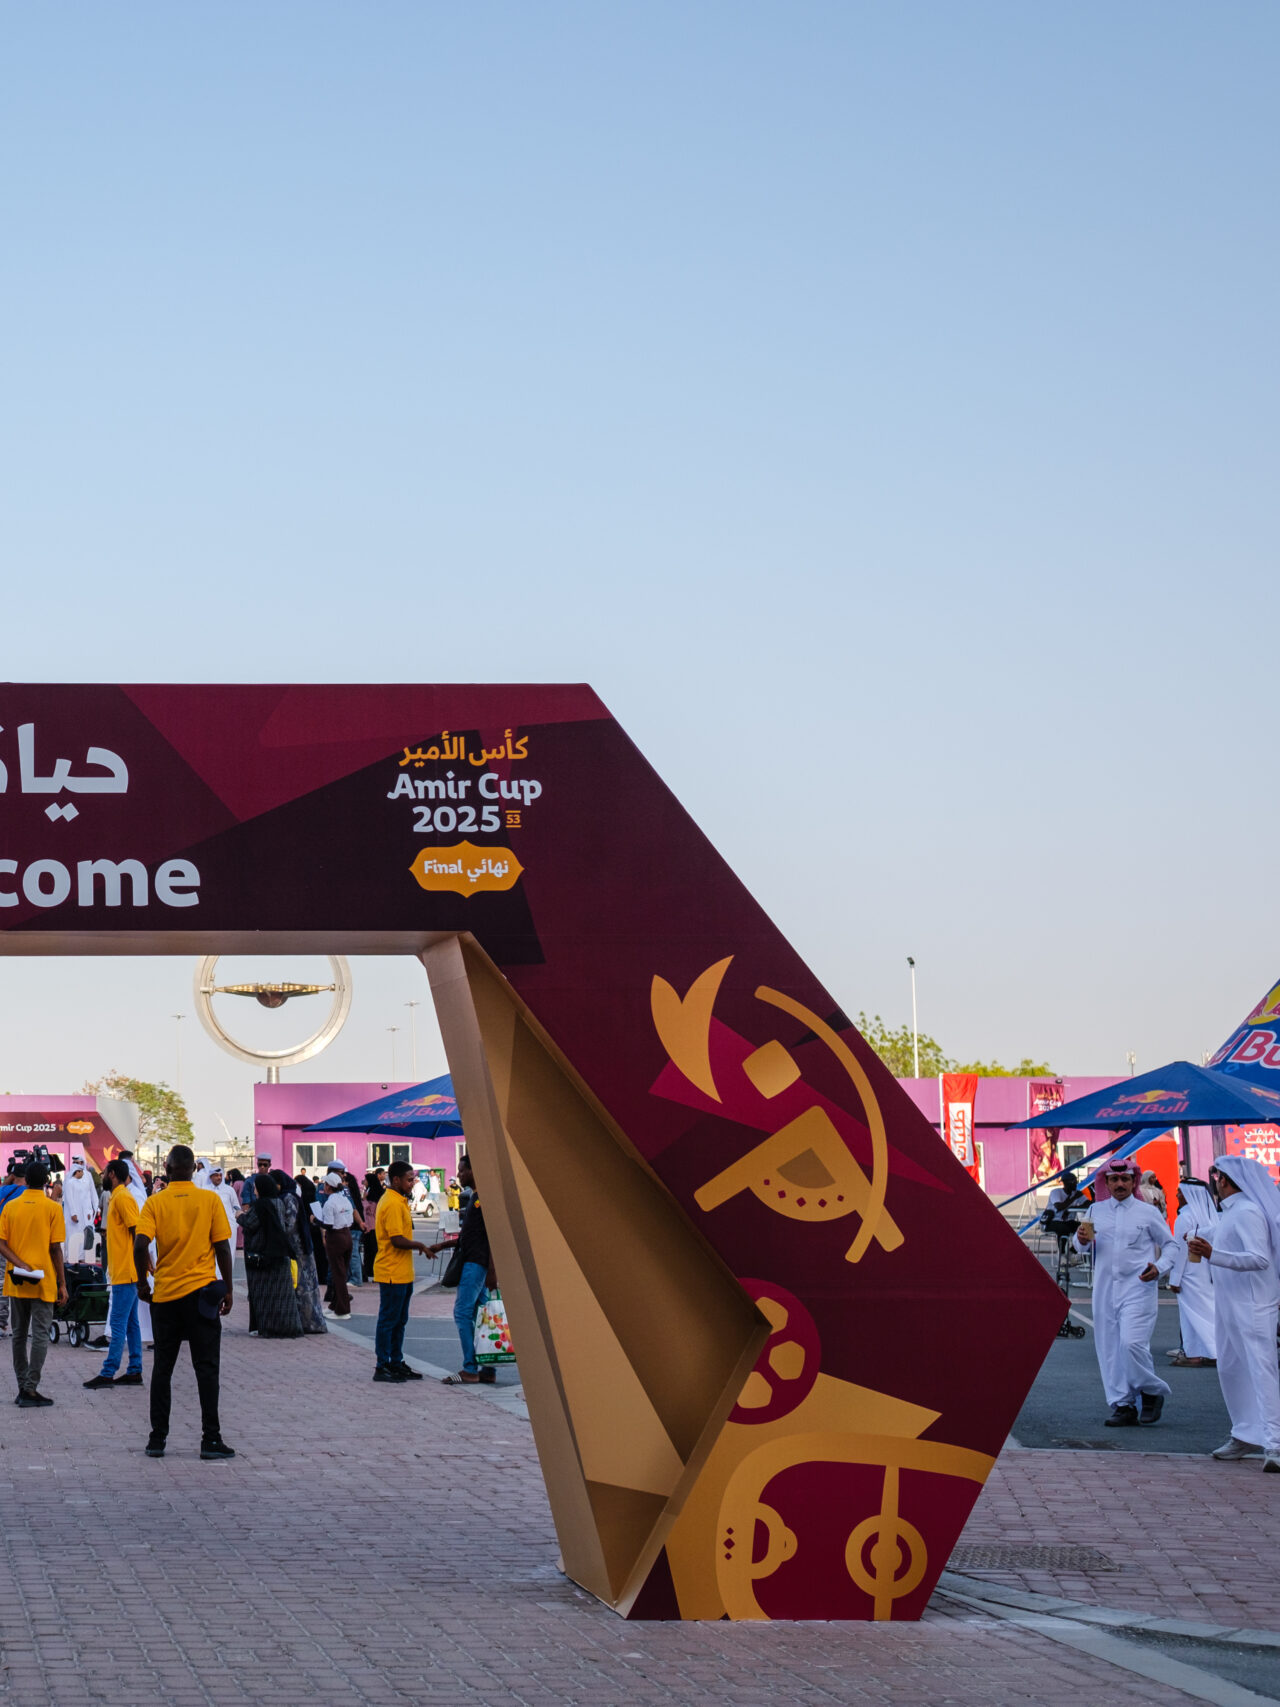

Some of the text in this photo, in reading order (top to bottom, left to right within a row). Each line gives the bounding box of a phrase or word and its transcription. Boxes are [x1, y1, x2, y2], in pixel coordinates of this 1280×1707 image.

[398, 729, 529, 768] كأس الأمير
[387, 770, 542, 806] Amir Cup
[412, 805, 521, 833] 2025 53
[424, 859, 509, 883] Final نهائي
[377, 1105, 458, 1121] Red Bull
[1095, 1101, 1190, 1118] Red Bull
[16, 1124, 32, 1133] Cup
[33, 1124, 56, 1132] 2025
